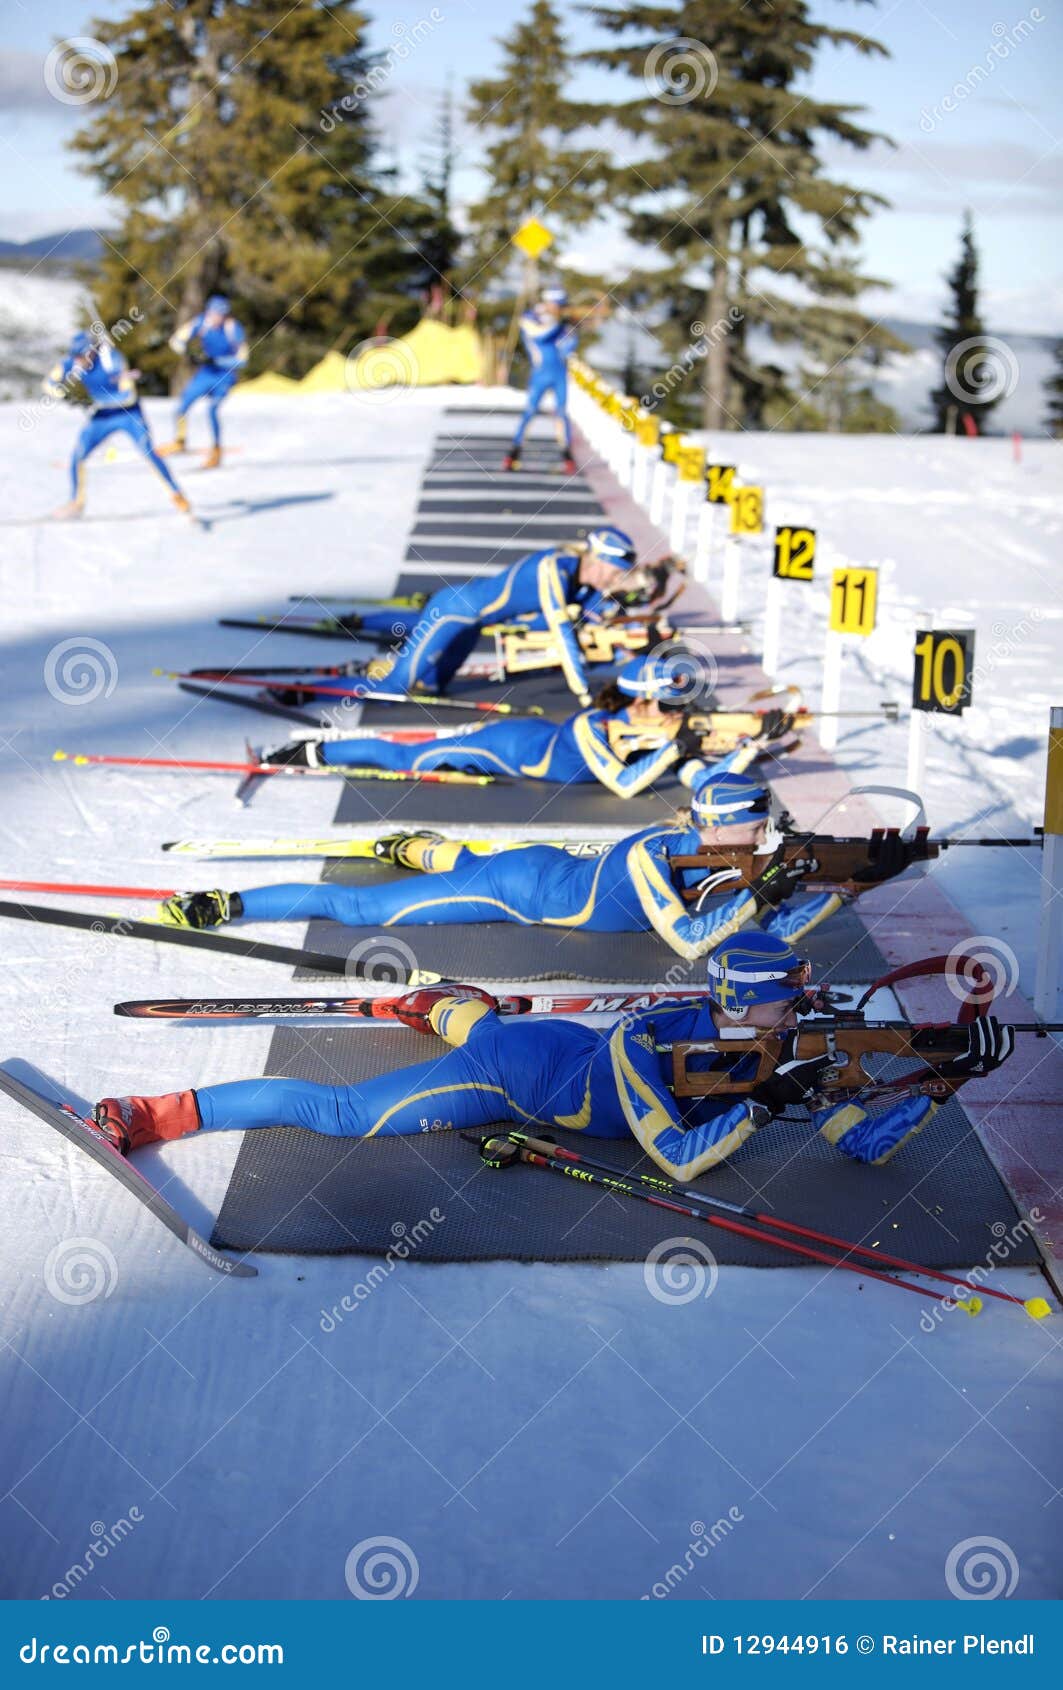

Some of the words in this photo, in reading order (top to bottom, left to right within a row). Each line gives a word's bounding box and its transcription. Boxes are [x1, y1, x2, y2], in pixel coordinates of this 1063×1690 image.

[734, 492, 759, 530] 13
[775, 527, 817, 579] 12
[835, 574, 867, 627] 11
[915, 633, 965, 708] 10
[186, 1004, 327, 1014] MADSHUS
[564, 1166, 594, 1183] LEKI
[191, 1237, 233, 1273] MADSHUS
